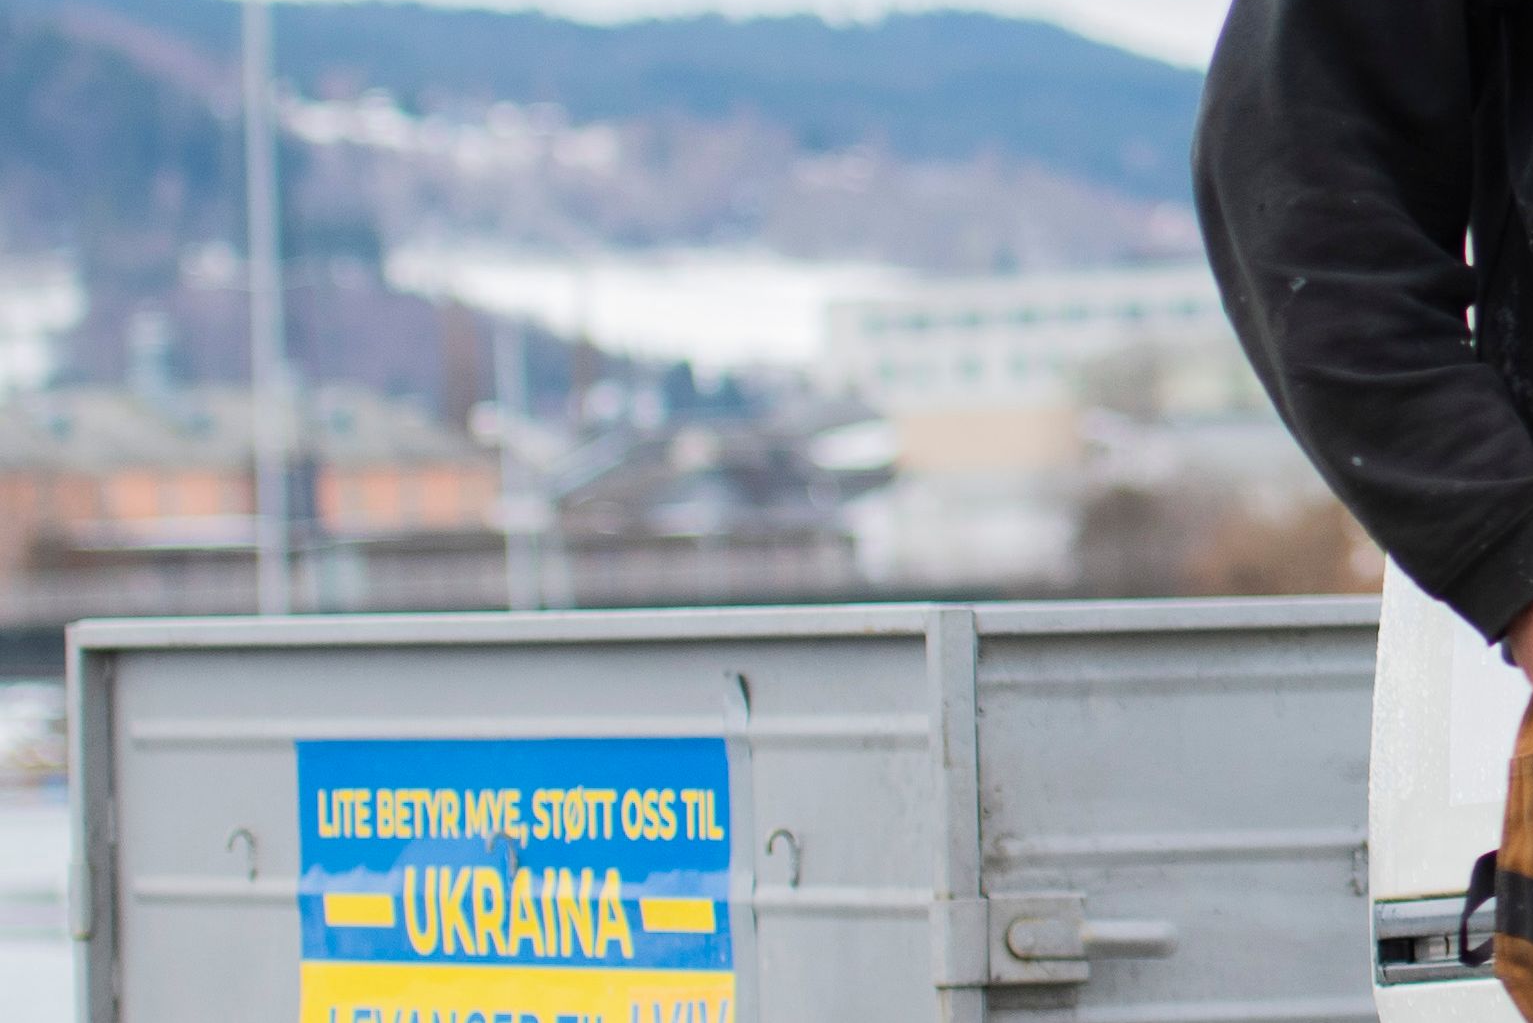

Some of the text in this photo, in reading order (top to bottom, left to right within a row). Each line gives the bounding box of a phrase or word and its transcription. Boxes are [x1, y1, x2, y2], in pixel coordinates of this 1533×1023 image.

[318, 785, 725, 849] LITE BETYR MYE, STØTT OSS TIL
[403, 865, 635, 959] UKRAINA
